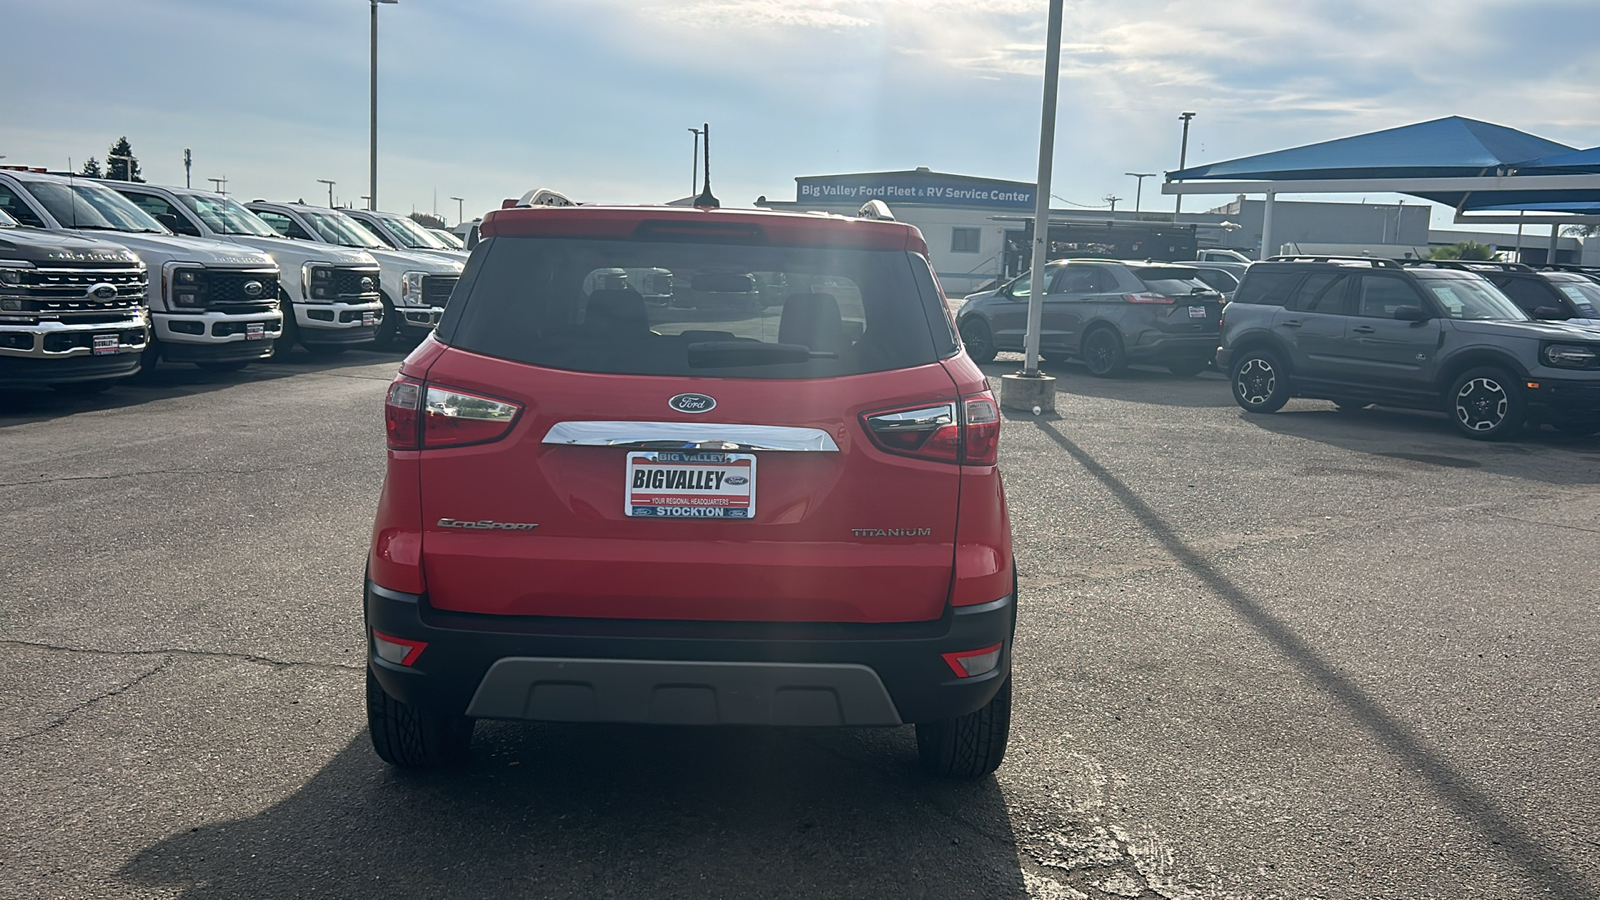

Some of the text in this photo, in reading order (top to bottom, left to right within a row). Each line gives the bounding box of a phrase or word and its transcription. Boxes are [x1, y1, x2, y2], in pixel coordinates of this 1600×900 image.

[802, 185, 820, 196] Big
[823, 186, 857, 197] Valley
[860, 186, 884, 196] Ford
[888, 186, 916, 196] Fleet
[927, 188, 944, 197] RV
[946, 188, 988, 199] Service
[991, 190, 1030, 202] Center
[679, 396, 706, 408] Ford
[659, 453, 724, 462] BIG VALLEY
[632, 469, 726, 490] BIGVALLEY
[656, 506, 724, 516] STOCKTON
[852, 528, 931, 536] TITANIUM
